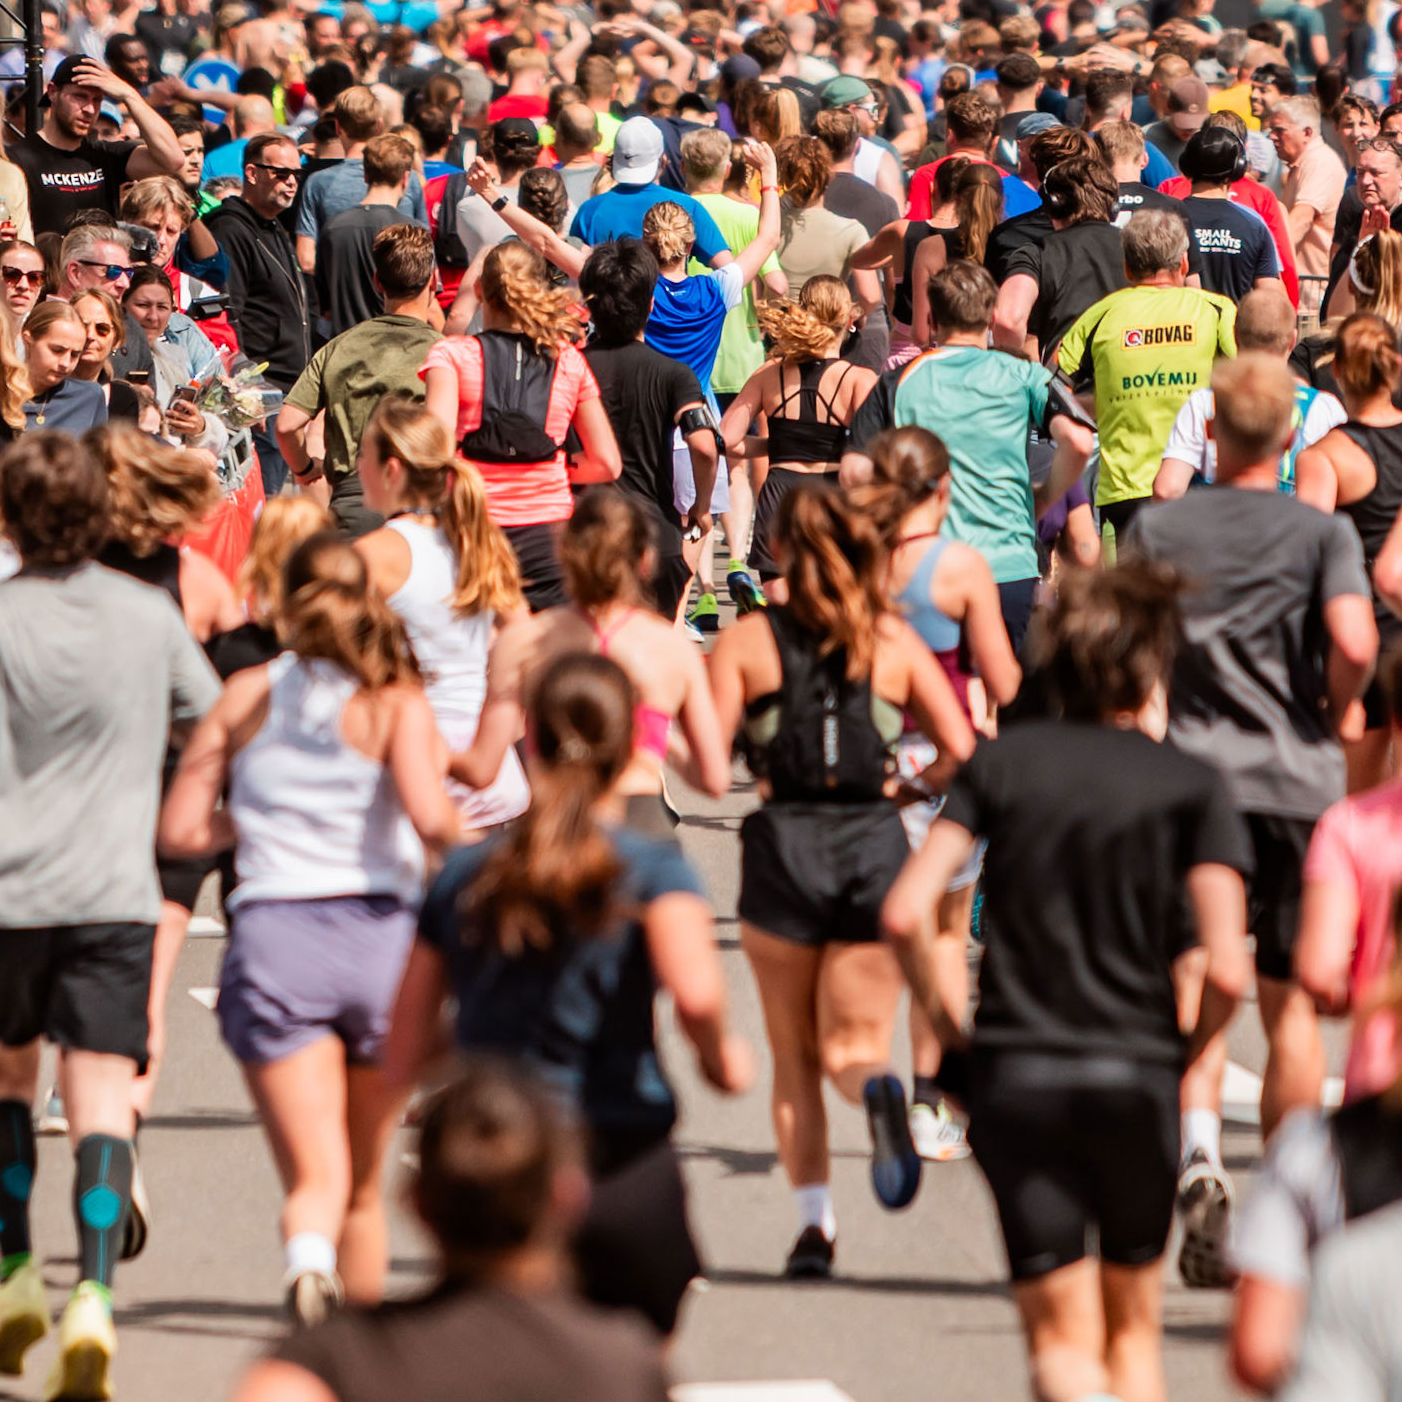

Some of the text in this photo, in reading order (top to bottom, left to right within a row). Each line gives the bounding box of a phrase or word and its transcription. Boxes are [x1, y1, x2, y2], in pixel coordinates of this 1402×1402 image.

[1194, 229, 1232, 240] SMALL
[1199, 236, 1242, 249] GIANTS
[1144, 324, 1193, 345] BOVAG
[1122, 362, 1198, 391] BOVEMIJ
